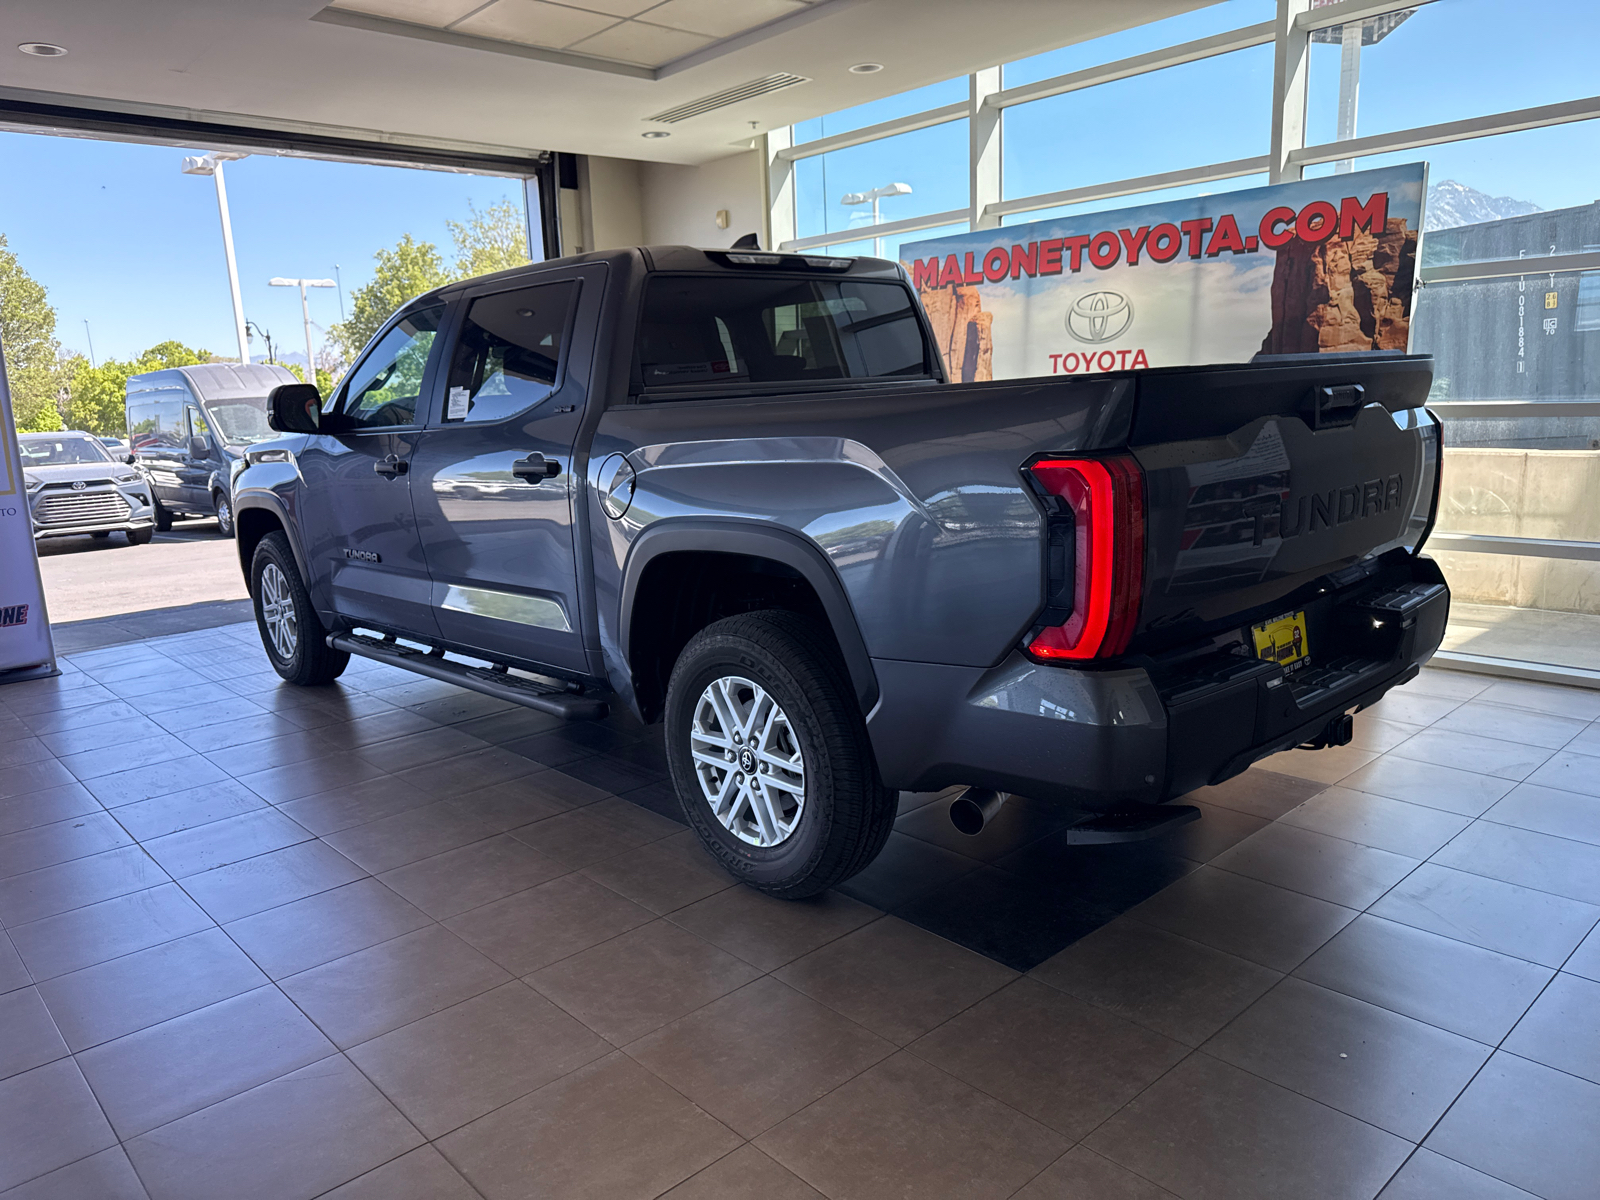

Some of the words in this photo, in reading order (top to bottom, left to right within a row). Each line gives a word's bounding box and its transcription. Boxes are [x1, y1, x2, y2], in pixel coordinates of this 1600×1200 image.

[913, 192, 1389, 291] MALONETOYOTA.COM
[1048, 348, 1150, 374] TOYOTA
[1243, 473, 1402, 547] TUNDRA
[343, 548, 380, 563] TUNDRA
[0, 604, 29, 627] NE
